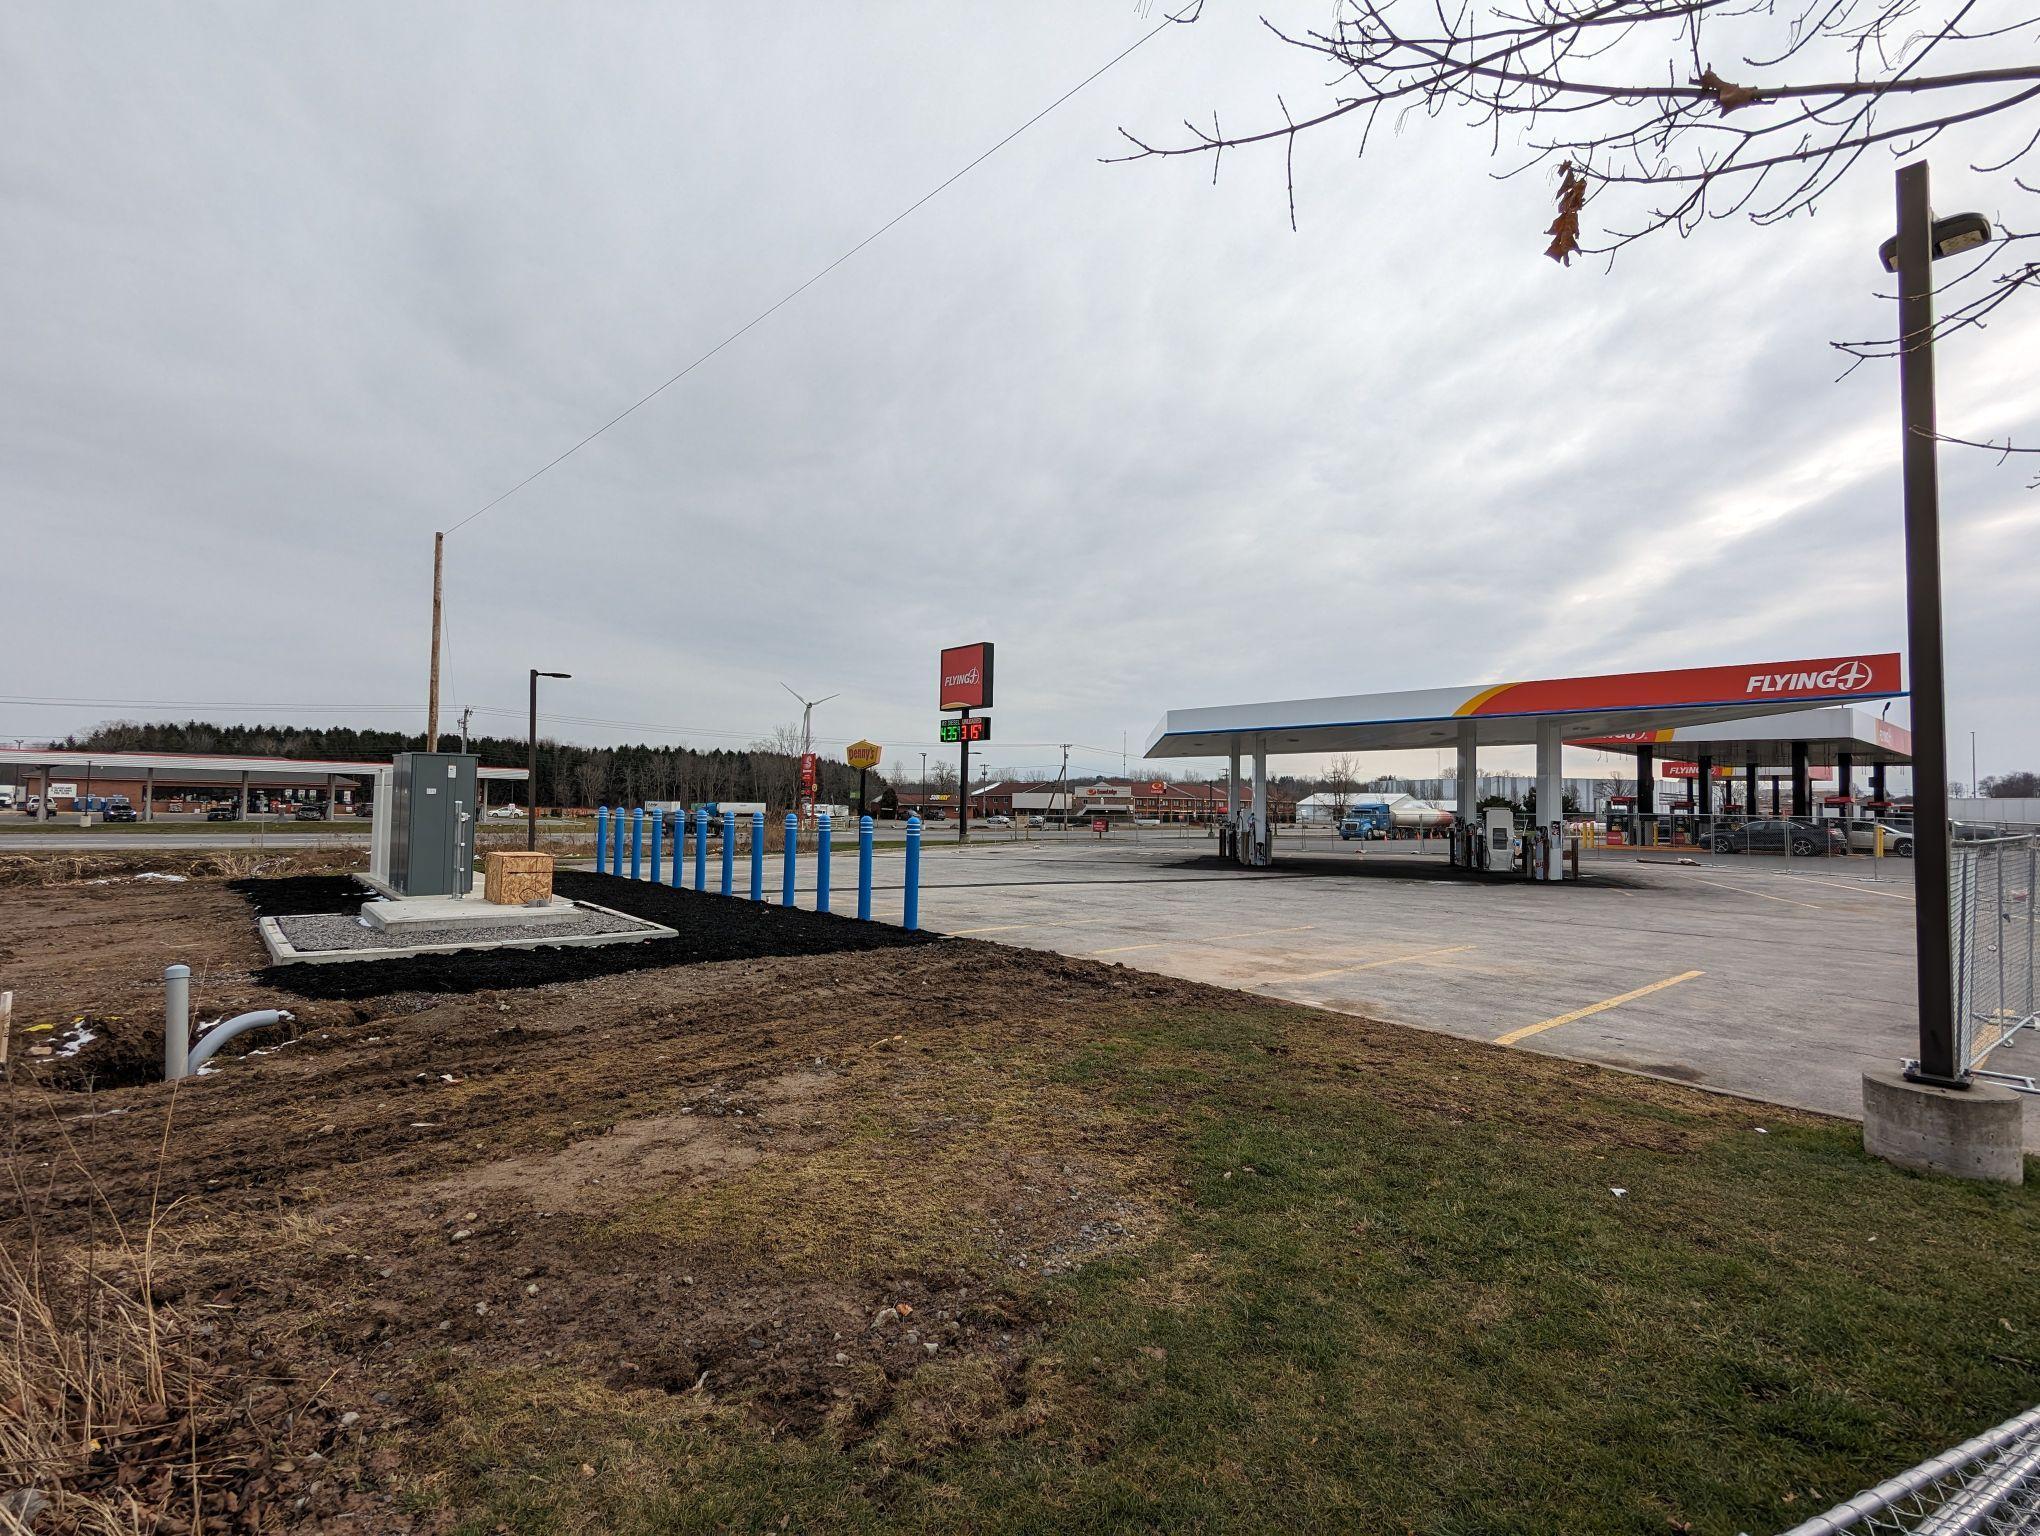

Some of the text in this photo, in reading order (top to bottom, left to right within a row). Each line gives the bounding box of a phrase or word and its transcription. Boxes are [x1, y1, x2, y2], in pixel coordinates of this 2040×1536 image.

[944, 673, 970, 687] FLYING
[1746, 671, 1837, 693] FLYING
[848, 746, 875, 762] Denny's
